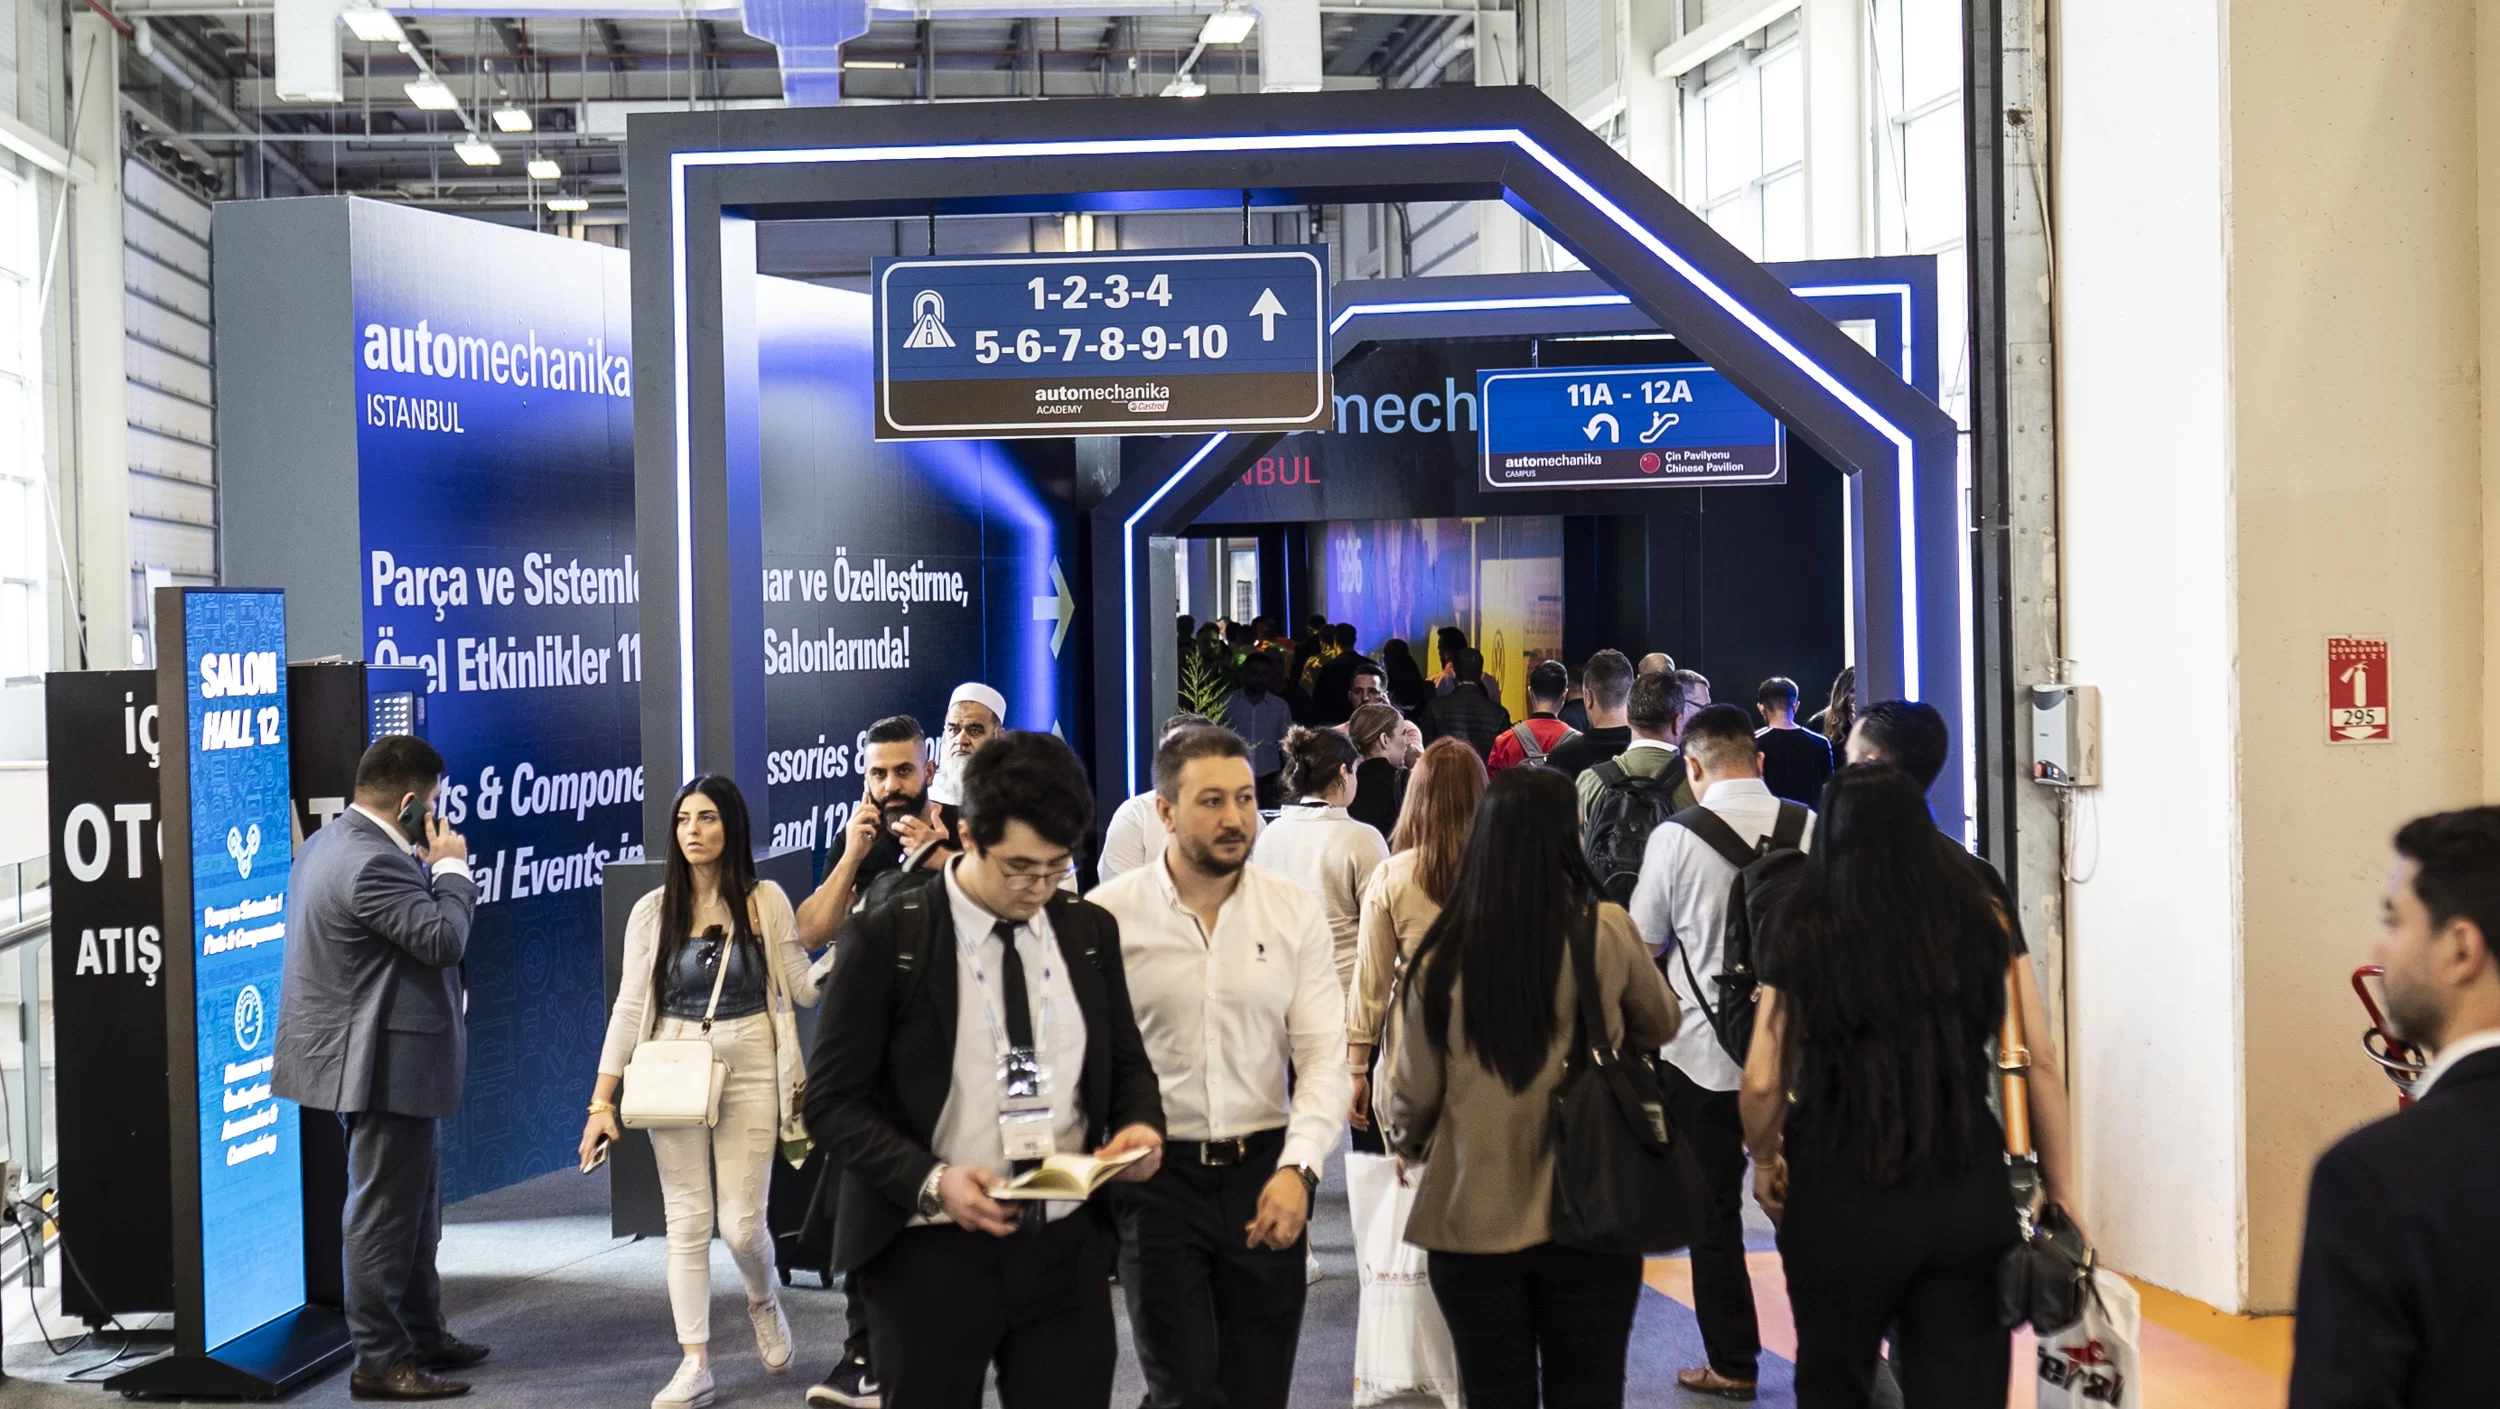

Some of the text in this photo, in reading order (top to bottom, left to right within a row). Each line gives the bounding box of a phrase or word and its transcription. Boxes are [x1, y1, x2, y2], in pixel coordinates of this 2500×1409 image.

[1028, 274, 1172, 310] 1-2-3-4
[364, 319, 631, 397] automechanika
[975, 324, 1228, 364] 5-6-7-8-9-10
[1035, 382, 1170, 401] automechanika
[1036, 405, 1083, 414] ACADEMY
[1137, 402, 1165, 410] Castrol
[1567, 383, 1613, 406] 11A
[1641, 380, 1693, 404] 12A
[367, 394, 464, 433] ISTANBUL
[1505, 453, 1602, 468] automechanika
[1505, 469, 1536, 478] CAMPUS
[1665, 451, 1730, 462] Çin Pavilyonu
[1666, 462, 1744, 473] Chinese Pavilion
[371, 550, 639, 622] Parça ve Sisteml
[799, 569, 828, 602] ve
[833, 546, 969, 614] Özelleştirme,
[374, 626, 447, 694] Öel
[457, 634, 611, 692] Etkinlikler
[764, 626, 910, 676] Salonlarında!
[201, 651, 278, 699] SALON
[202, 705, 280, 752] HALL 12
[2343, 708, 2376, 726] 295
[437, 775, 468, 825] ts
[477, 766, 503, 821] &
[772, 800, 861, 851] and 12
[511, 842, 610, 900] Events
[76, 926, 162, 986] ATIŞ
